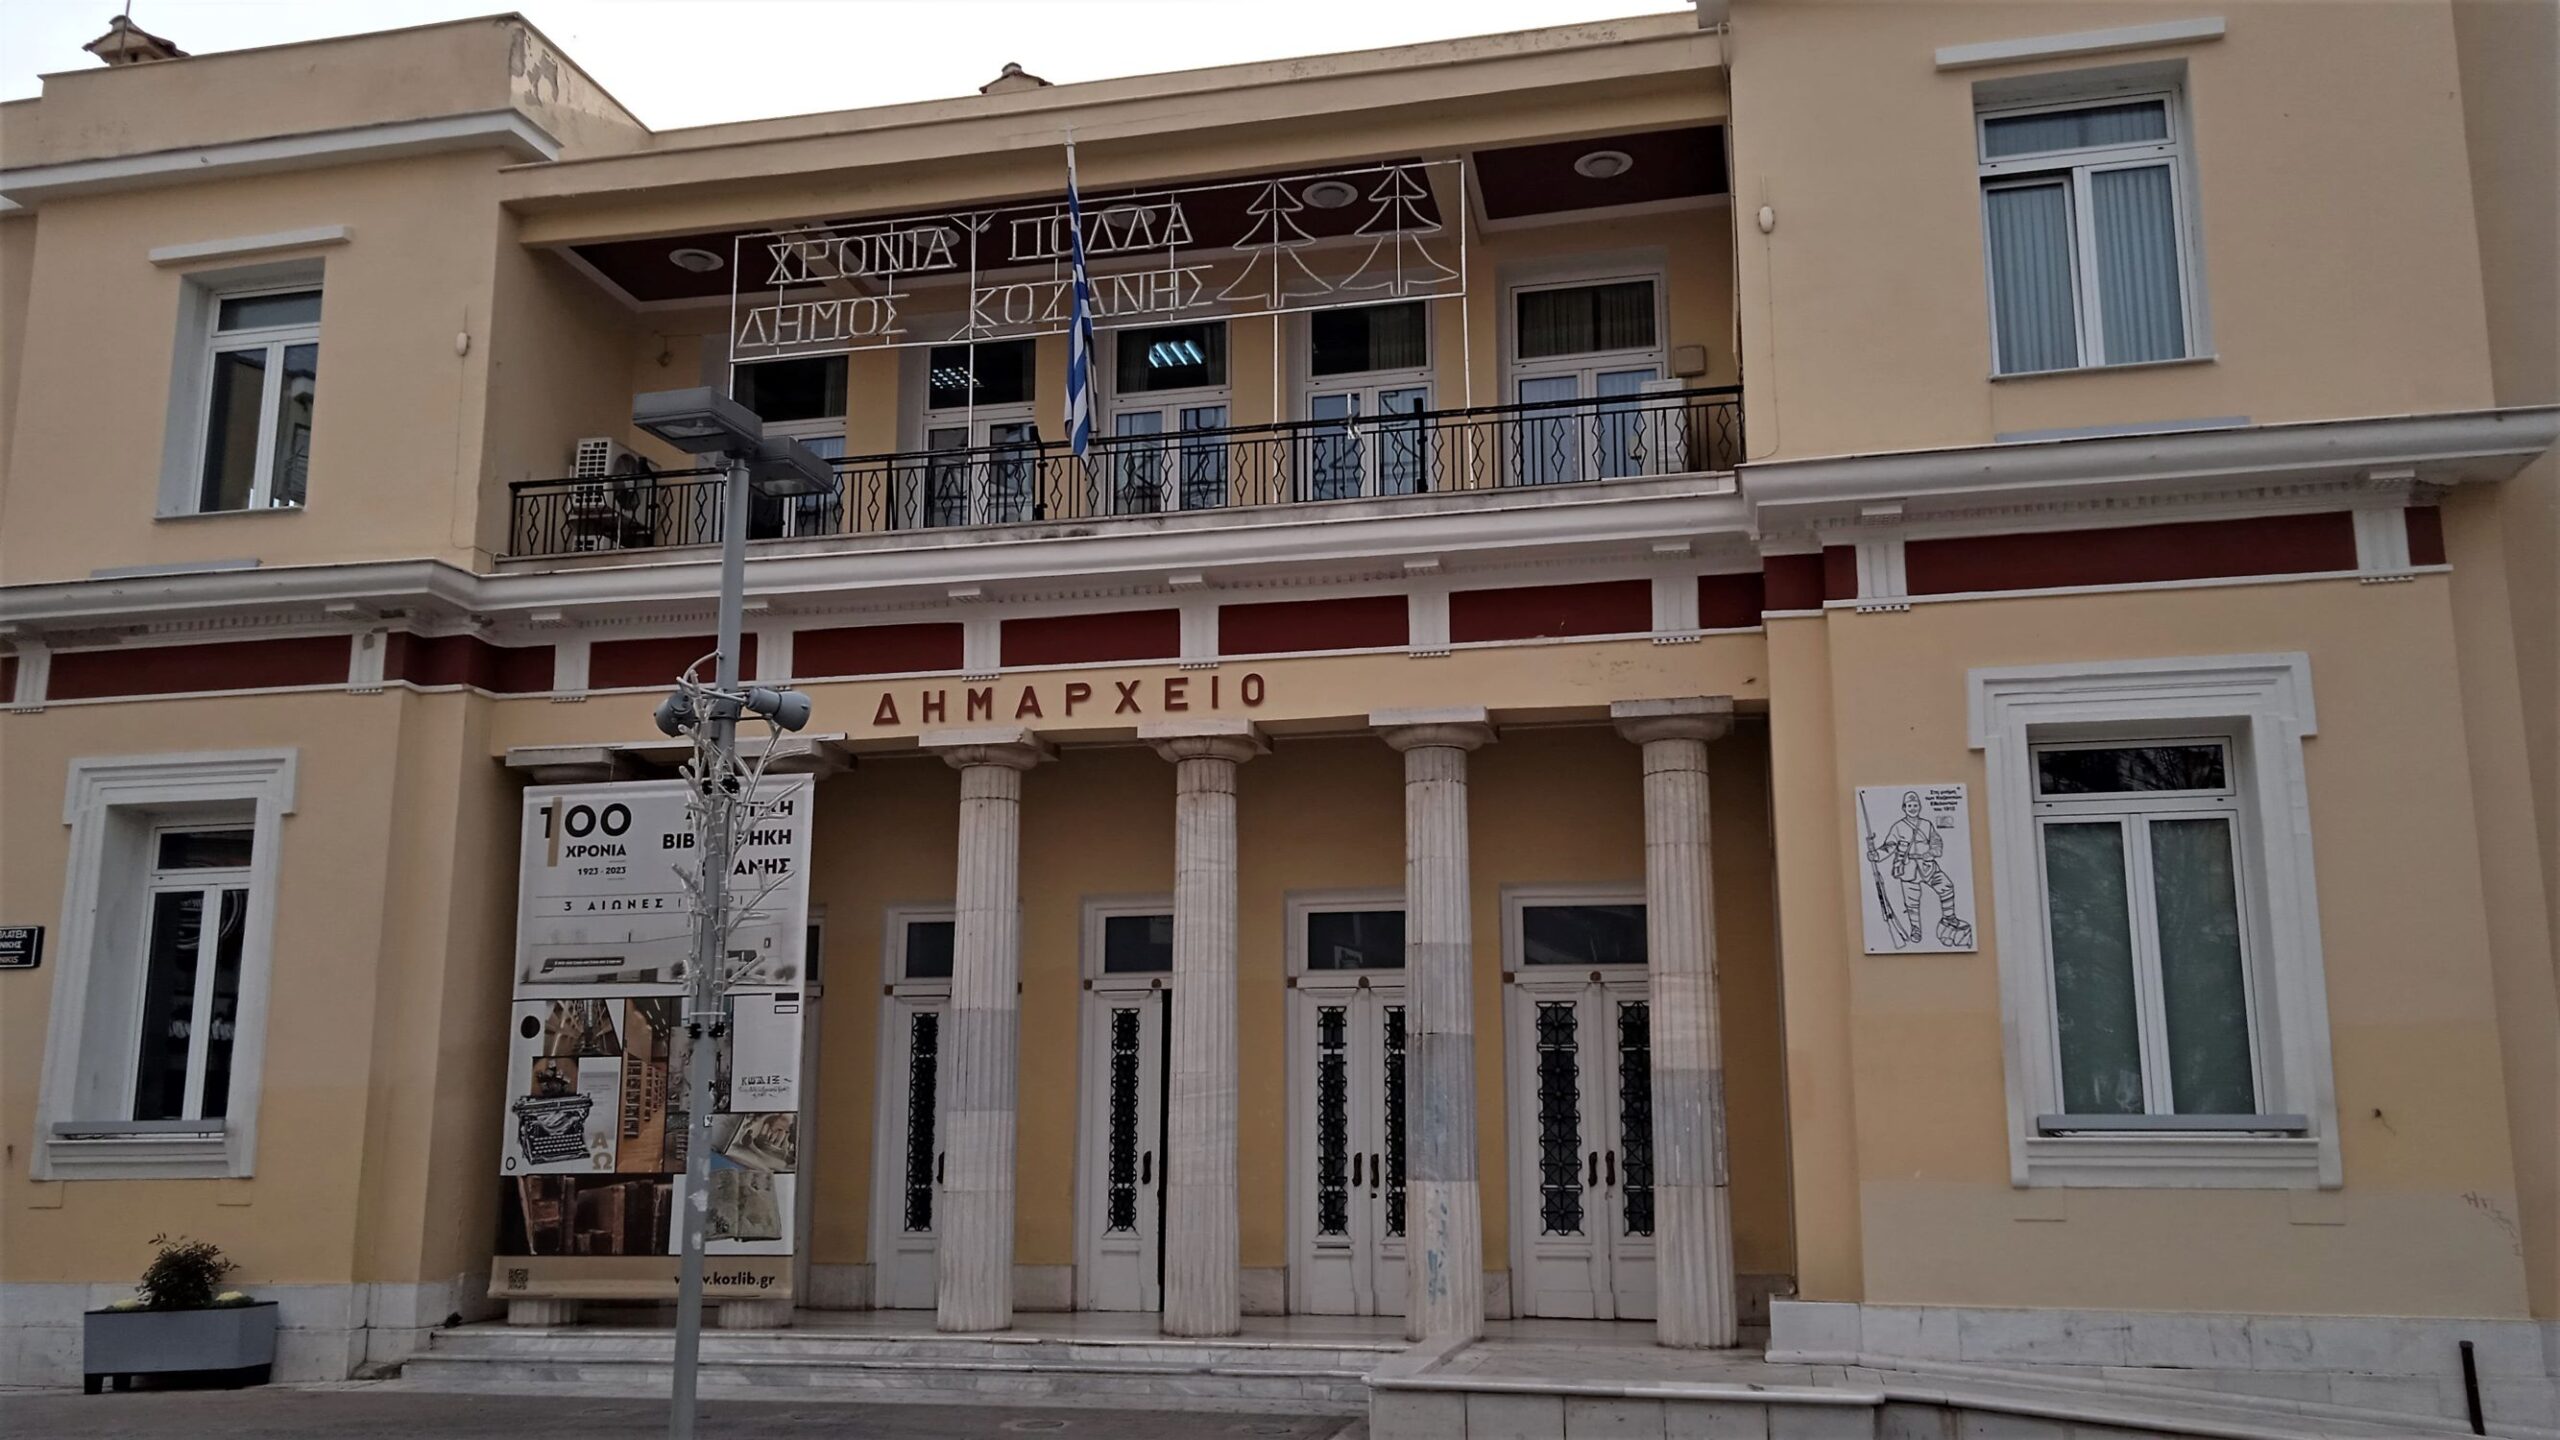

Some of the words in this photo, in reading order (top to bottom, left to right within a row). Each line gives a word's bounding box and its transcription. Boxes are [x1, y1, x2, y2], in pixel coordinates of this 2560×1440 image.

[767, 226, 957, 285] ΧΡΟΝΙΑ
[737, 293, 910, 348] ΔΗΜΟΣ
[873, 673, 1266, 726] ΔΗΜΑΡΧΕΙΟ
[540, 803, 632, 839] 100
[662, 829, 792, 849] ΒΙΒΗΚΗ
[565, 844, 627, 858] ΧΡΟΝΙΑ
[578, 867, 599, 876] 1923
[605, 866, 626, 875] 2023
[564, 901, 572, 911] 3
[587, 898, 663, 911] ΑΙΩΝΕΣ
[593, 1152, 613, 1170] Ω
[674, 1272, 775, 1289] w.kozlib.gr
